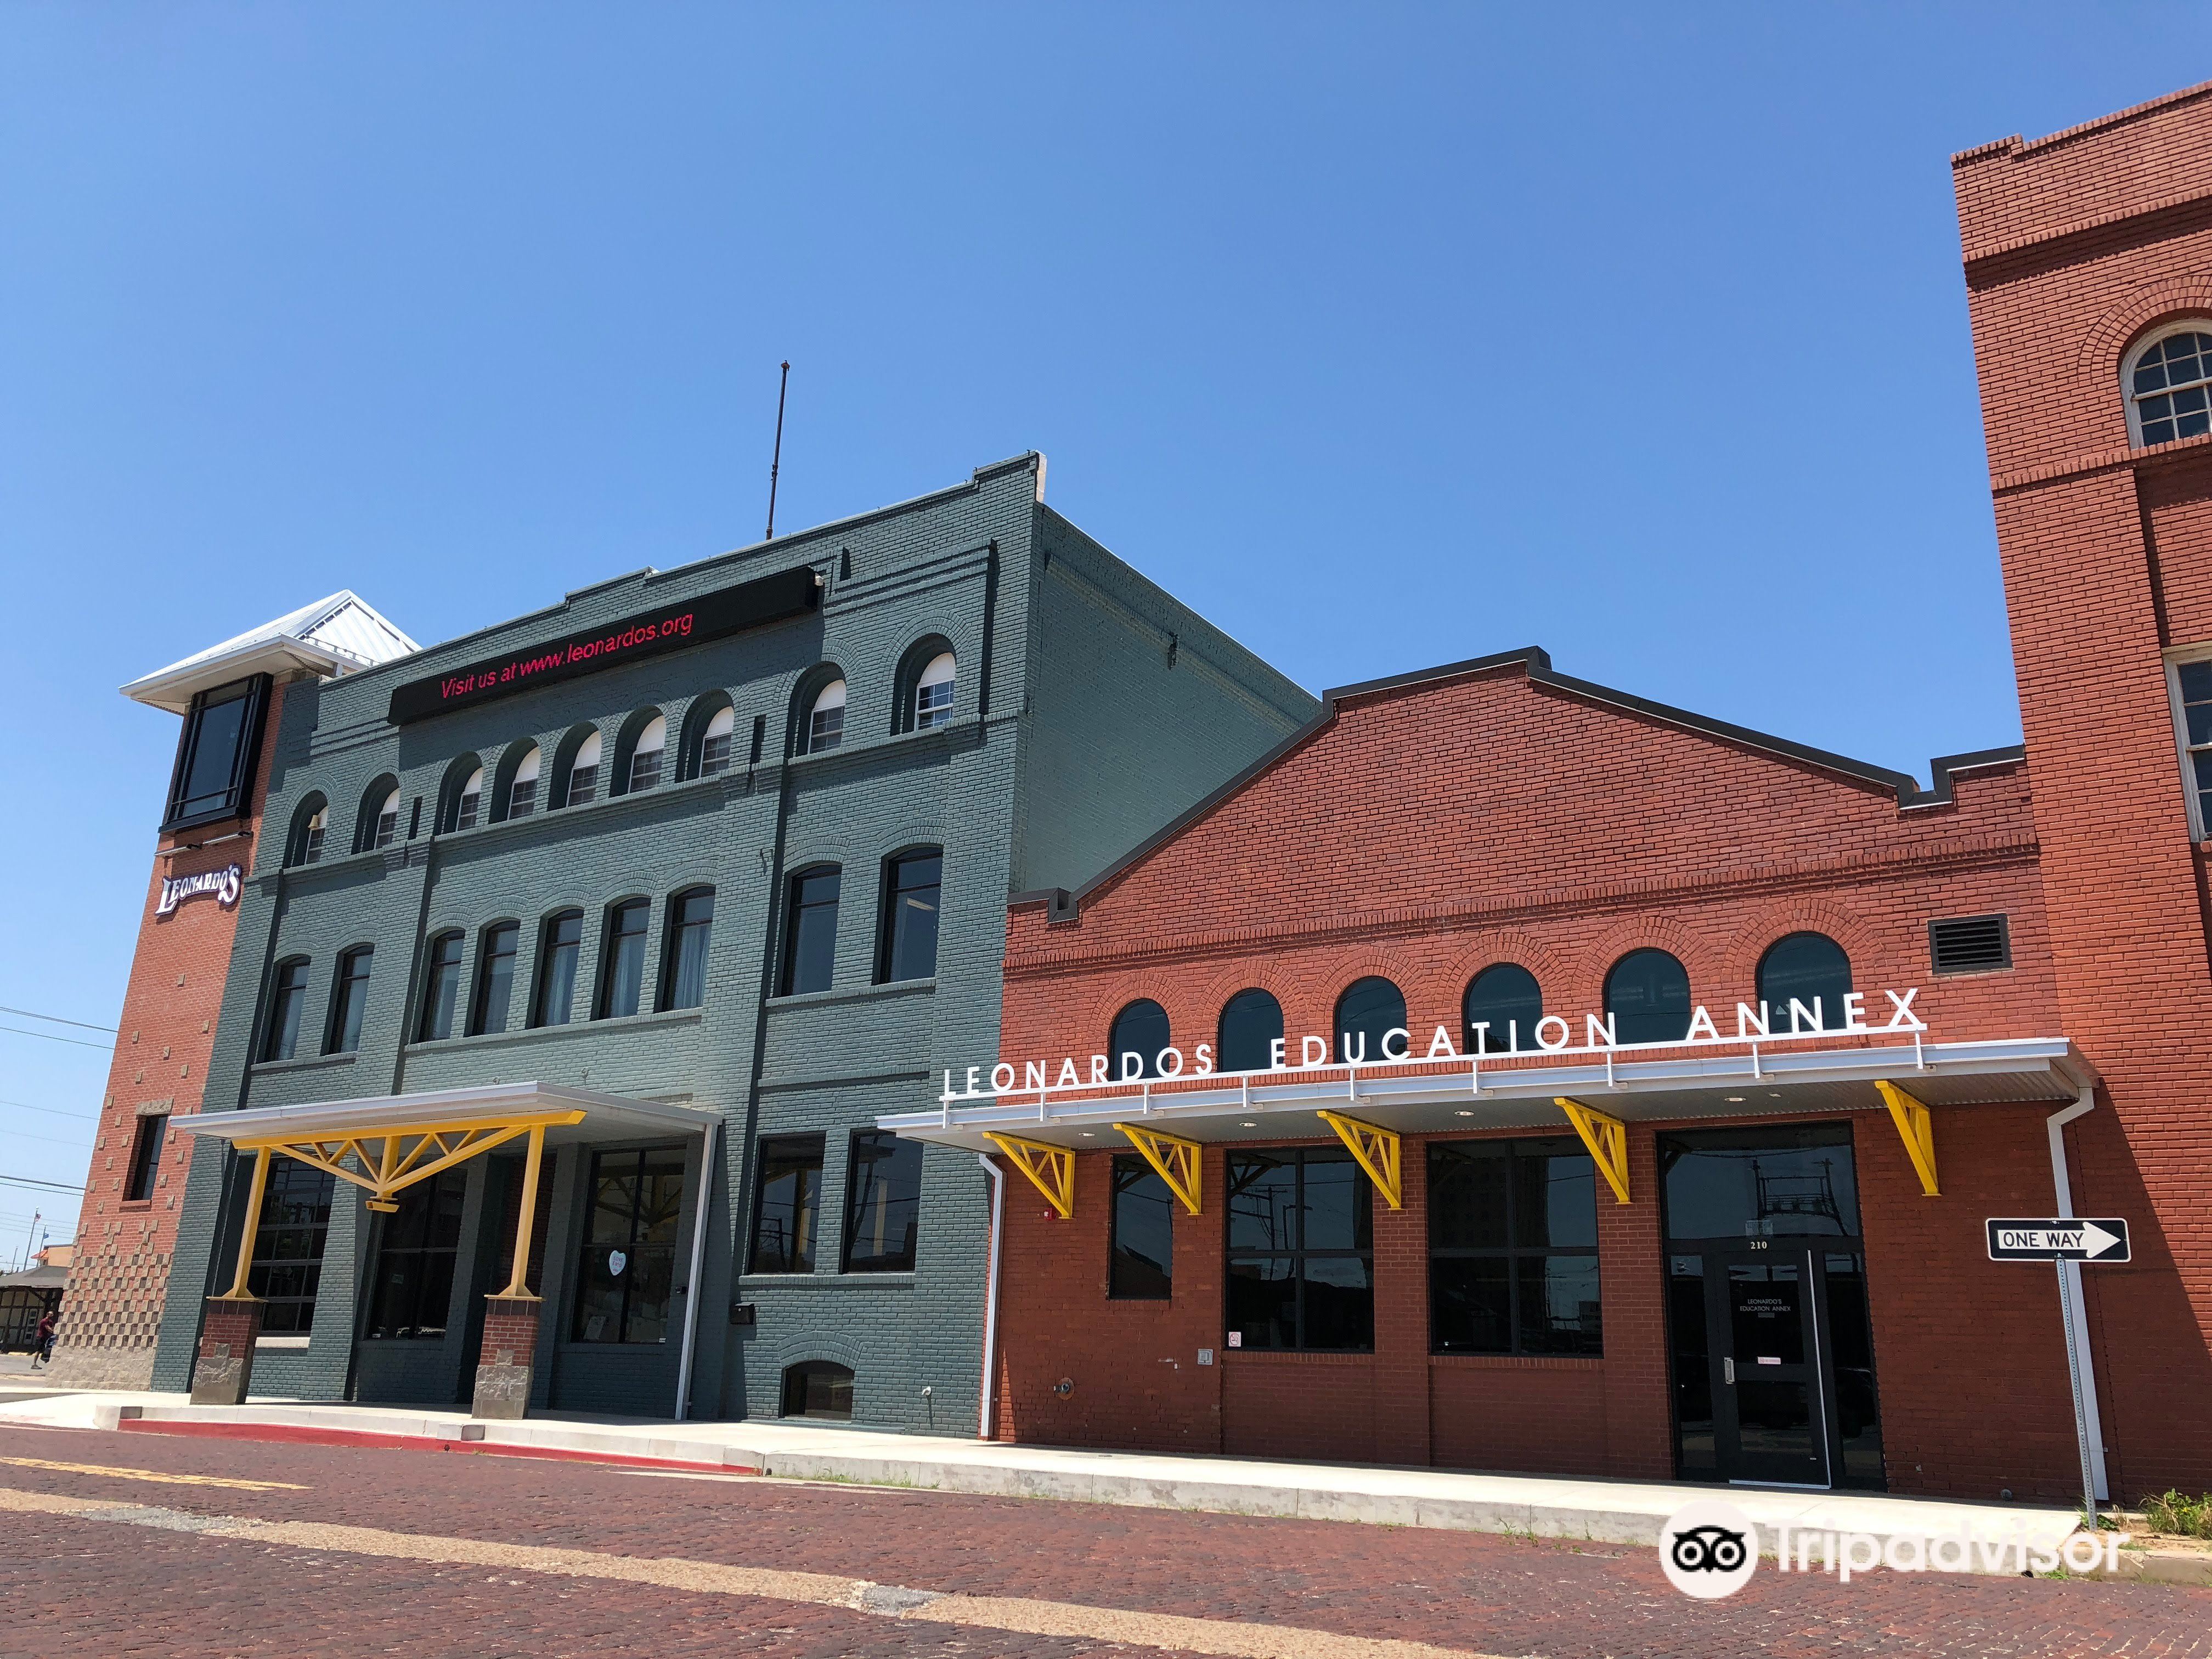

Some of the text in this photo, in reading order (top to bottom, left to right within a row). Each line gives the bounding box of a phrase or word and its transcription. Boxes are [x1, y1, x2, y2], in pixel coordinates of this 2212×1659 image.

[441, 613, 693, 698] Visit us at www.leonardos.org
[944, 988, 1922, 1096] LEONARDOS EDUCATION ANNEX
[1750, 1241, 1768, 1250] 210
[2003, 1232, 2084, 1248] ONE WAY
